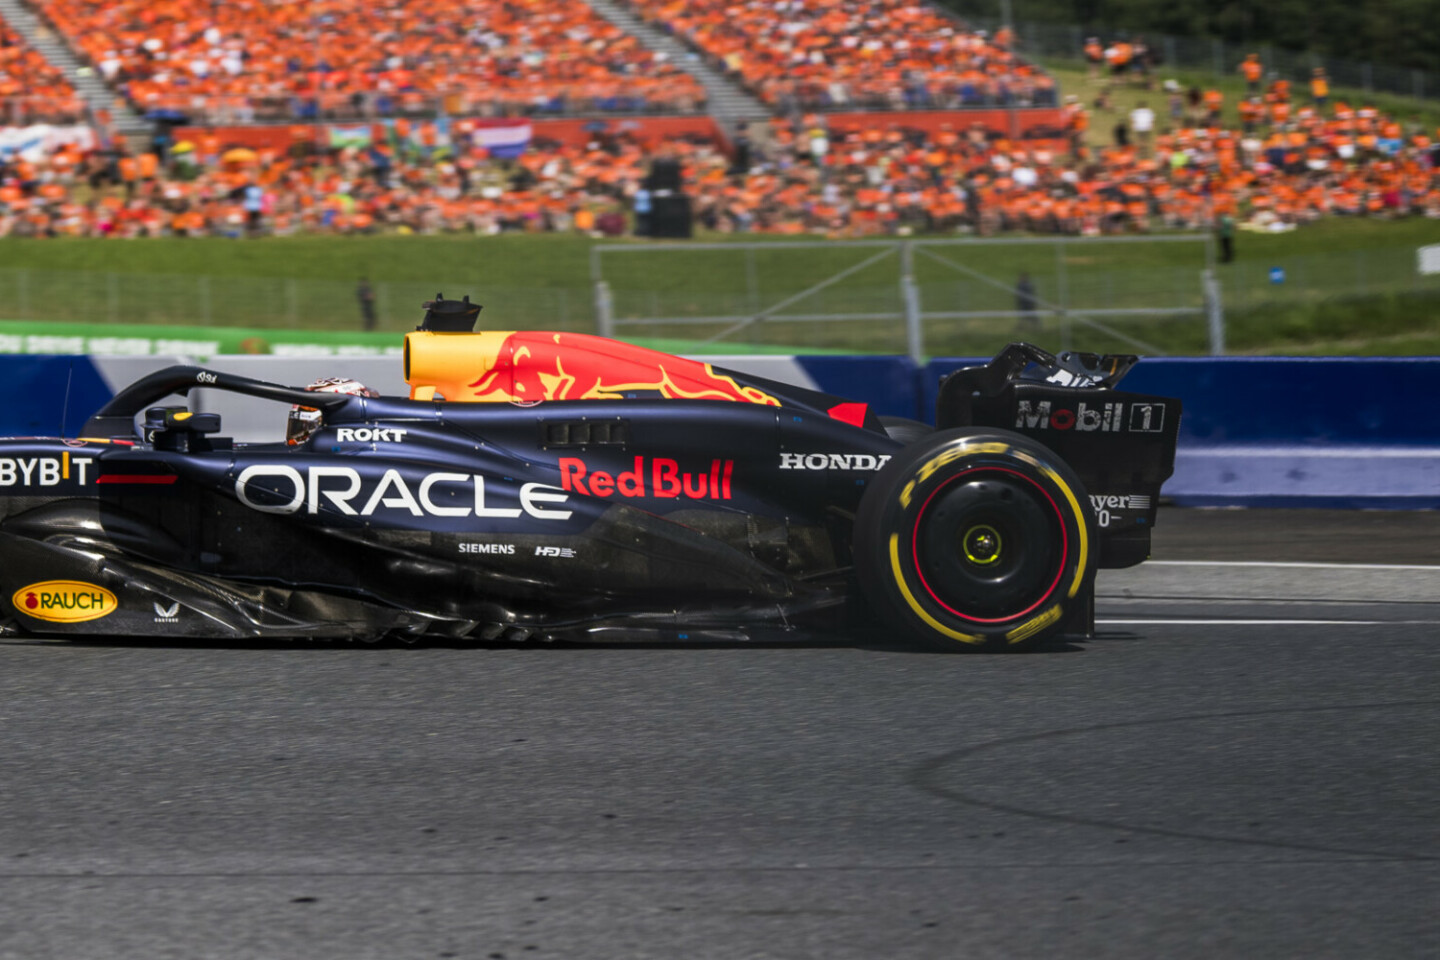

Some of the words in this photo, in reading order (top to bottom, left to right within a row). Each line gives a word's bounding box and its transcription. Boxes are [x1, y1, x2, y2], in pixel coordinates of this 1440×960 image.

[1015, 400, 1123, 432] Mobil
[336, 428, 408, 442] ROKT
[558, 455, 647, 497] Red
[652, 457, 734, 500] Bull
[235, 464, 574, 520] ORACLE
[458, 543, 516, 555] SIEMENS
[40, 592, 104, 610] RAUCH
